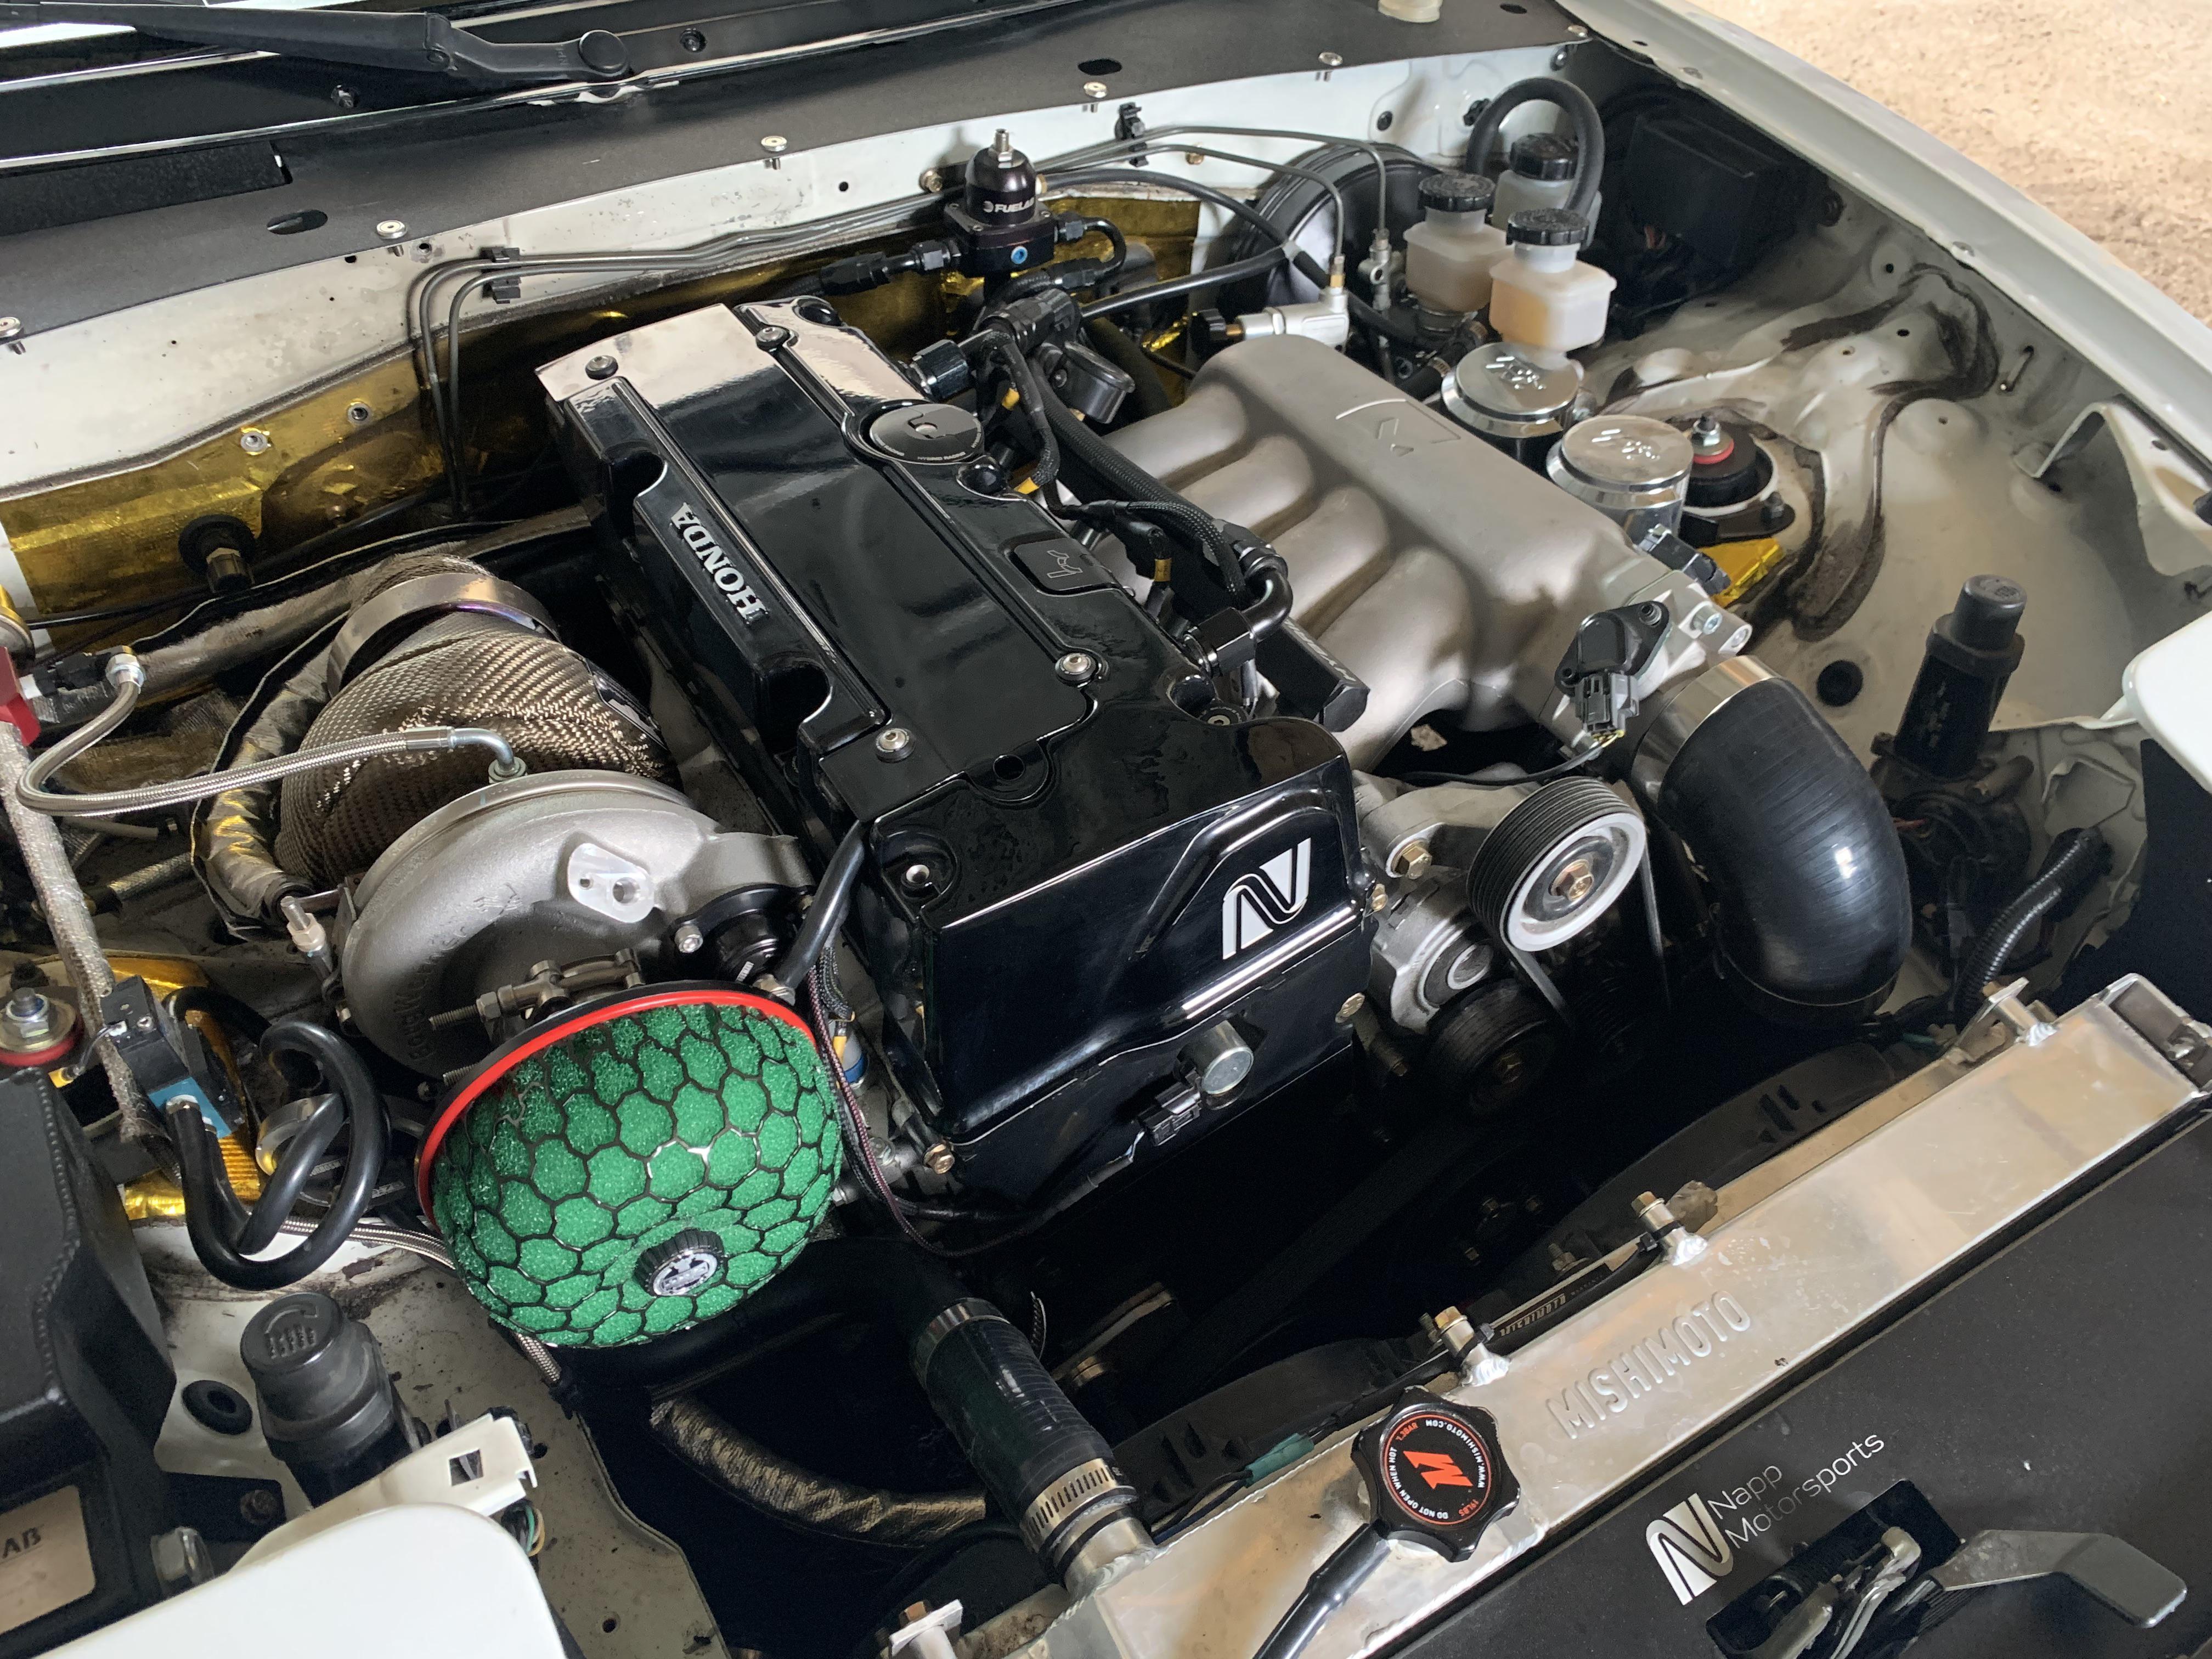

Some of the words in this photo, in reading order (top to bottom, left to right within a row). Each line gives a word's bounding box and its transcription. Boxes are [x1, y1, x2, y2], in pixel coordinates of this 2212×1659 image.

[670, 502, 770, 624] HONDA
[1545, 1289, 1752, 1440] MISHIMOTO
[1389, 1446, 1398, 1464] HOT
[1425, 1419, 1486, 1488] WWW.MISHIMOTO.COM
[1389, 1464, 1402, 1491] WHEN
[1399, 1489, 1420, 1509] OPEN
[1710, 1462, 1784, 1521] Napp
[1725, 1432, 1886, 1550] Motorsports
[1418, 1506, 1435, 1518] NOT
[1436, 1511, 1449, 1520] DO
